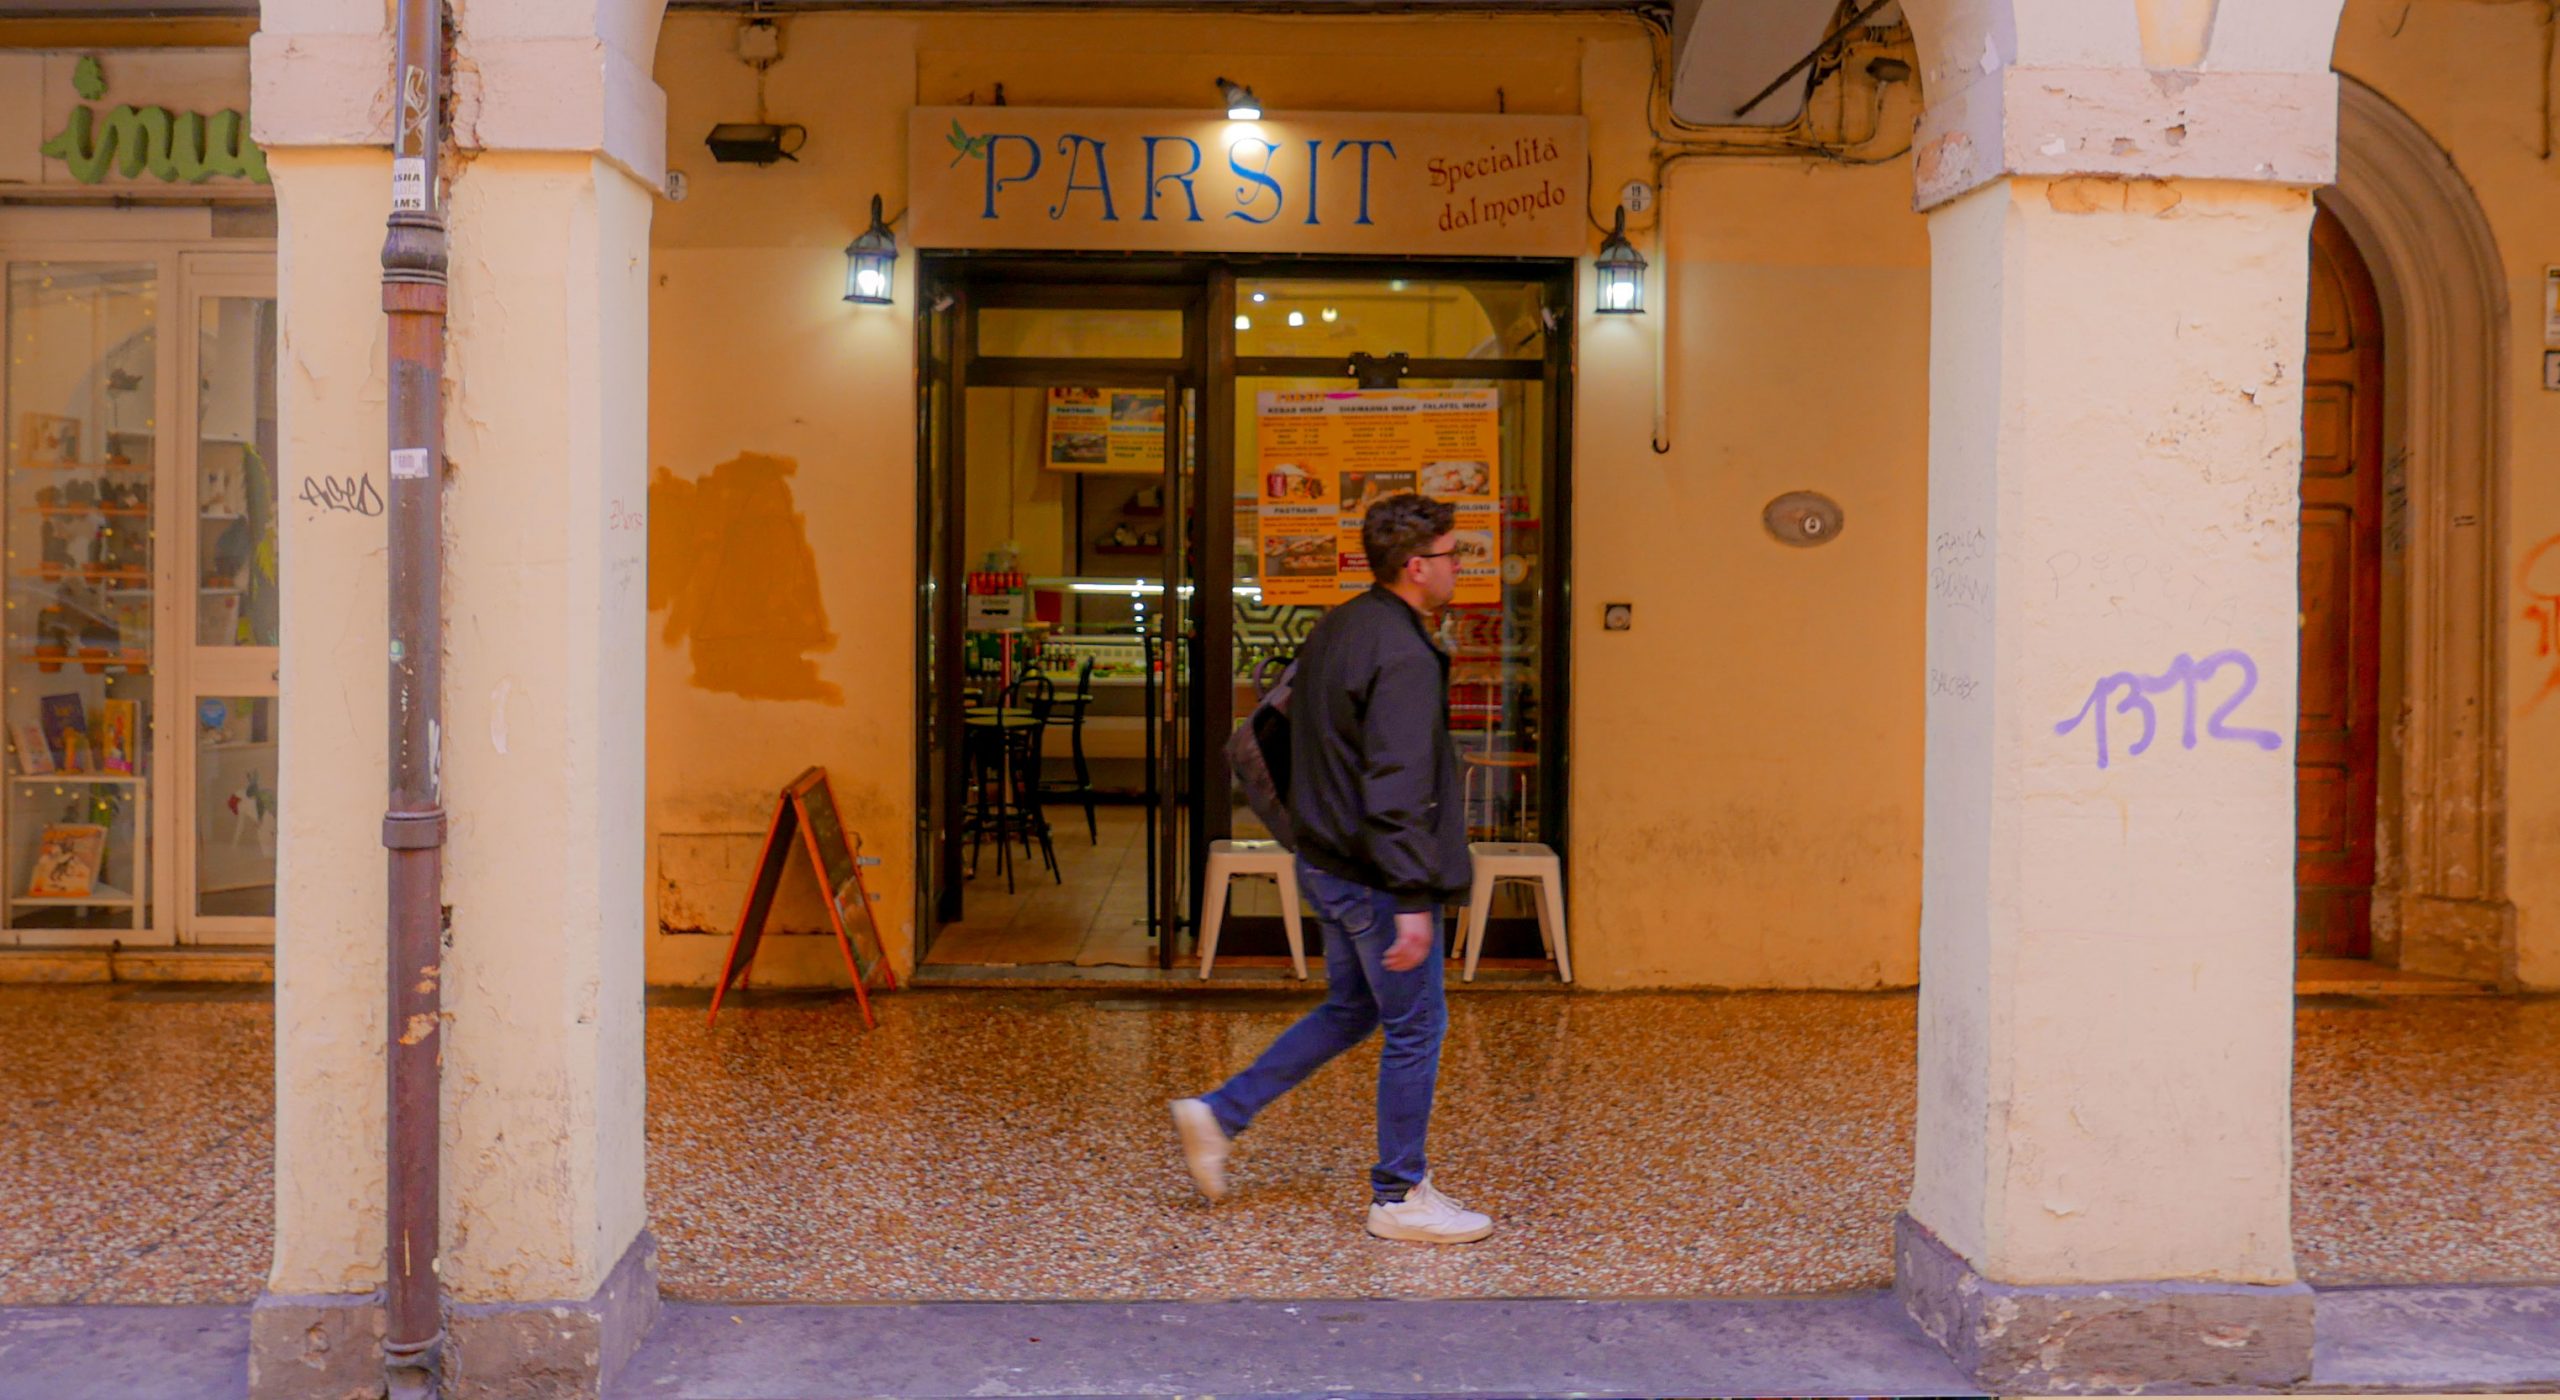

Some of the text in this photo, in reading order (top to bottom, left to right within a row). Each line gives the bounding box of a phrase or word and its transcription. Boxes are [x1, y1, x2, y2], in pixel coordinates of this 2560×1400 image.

[40, 55, 272, 184] inu
[981, 133, 1397, 225] PARSIT
[1438, 180, 1565, 232] dal mondo
[1392, 404, 1416, 412] WRAP
[1423, 402, 1459, 410] FALAFEL
[2054, 648, 2283, 769] 1312
